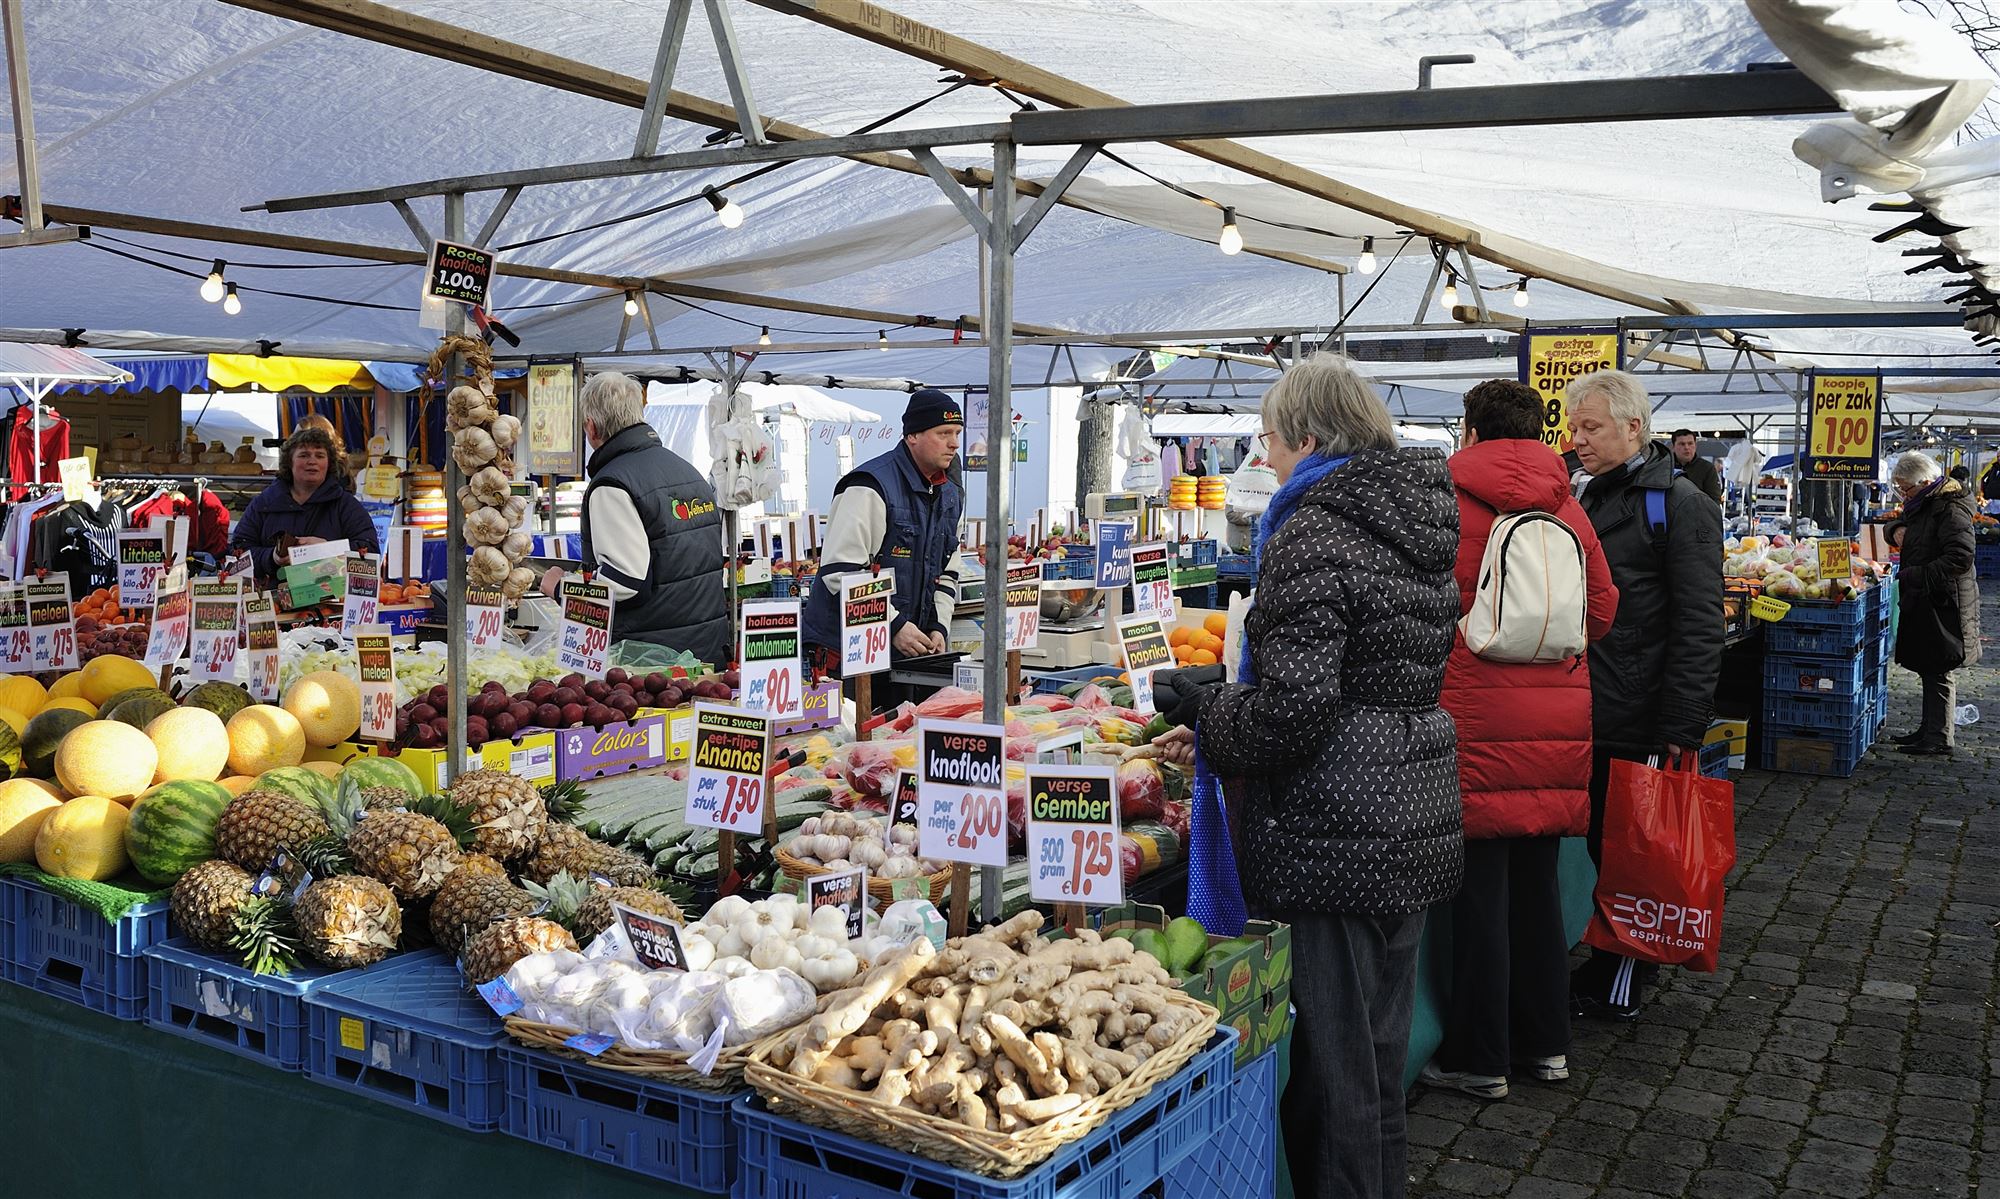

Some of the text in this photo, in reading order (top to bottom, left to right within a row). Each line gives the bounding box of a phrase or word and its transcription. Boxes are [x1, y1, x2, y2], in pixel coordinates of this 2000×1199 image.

[447, 246, 484, 263] Rode
[440, 254, 487, 276] knoflook
[435, 287, 482, 302] per stuk
[1554, 339, 1593, 349] extra
[1823, 379, 1865, 390] koopje
[533, 384, 571, 406] elstar
[1816, 387, 1872, 415] per zak
[858, 427, 872, 443] op
[878, 425, 893, 439] de
[123, 547, 161, 563] Litchee
[1112, 545, 1130, 559] kun
[1137, 552, 1161, 561] verse
[125, 569, 136, 577] per
[1007, 570, 1019, 578] ode
[1135, 566, 1166, 580] courgettes
[28, 585, 63, 593] cantaloupe
[123, 579, 135, 587] kilo
[854, 581, 883, 598] mix
[466, 586, 500, 605] ruiven
[565, 584, 606, 598] Larry-ann
[1140, 585, 1148, 600] 2
[32, 603, 68, 621] meloen
[157, 596, 186, 616] meloen
[196, 606, 235, 619] meloen
[247, 600, 270, 613] Galia
[567, 599, 608, 620] pruimen
[846, 599, 885, 618] Paprika
[748, 616, 794, 627] hollandse
[249, 625, 276, 645] meloen
[566, 624, 578, 635] per
[1127, 625, 1153, 636] mooie
[36, 635, 46, 648] per
[197, 639, 209, 650] per
[363, 639, 384, 648] zoete
[563, 635, 577, 649] kilo
[745, 637, 796, 658] komkommer
[849, 634, 861, 648] per
[36, 649, 49, 660] stuk
[194, 653, 209, 663] stuk
[363, 654, 385, 665] water
[561, 653, 571, 665] 500
[572, 656, 584, 668] gram
[847, 648, 862, 662] zak
[1130, 644, 1167, 668] paprika
[253, 660, 261, 674] per
[363, 664, 391, 680] meloen
[253, 677, 263, 688] stuk
[750, 678, 766, 698] per
[363, 695, 373, 707] per
[363, 709, 373, 722] stuk
[701, 713, 763, 730] extra sweet
[591, 727, 648, 756] Colors
[708, 733, 758, 751] eet-rijpe
[943, 735, 987, 752] verse
[697, 740, 761, 772] Ananas
[929, 749, 1001, 784] knoflook
[698, 777, 718, 792] per
[1047, 780, 1092, 793] verse
[693, 796, 718, 811] stuk
[933, 799, 953, 814] per
[1033, 792, 1110, 820] Gember
[928, 814, 956, 833] netje
[1040, 837, 1064, 863] 500
[1039, 863, 1066, 880] gram
[823, 876, 852, 892] verse
[815, 885, 858, 907] knoflook
[628, 922, 675, 949] knoflook
[1629, 929, 1704, 951] esprit.com
